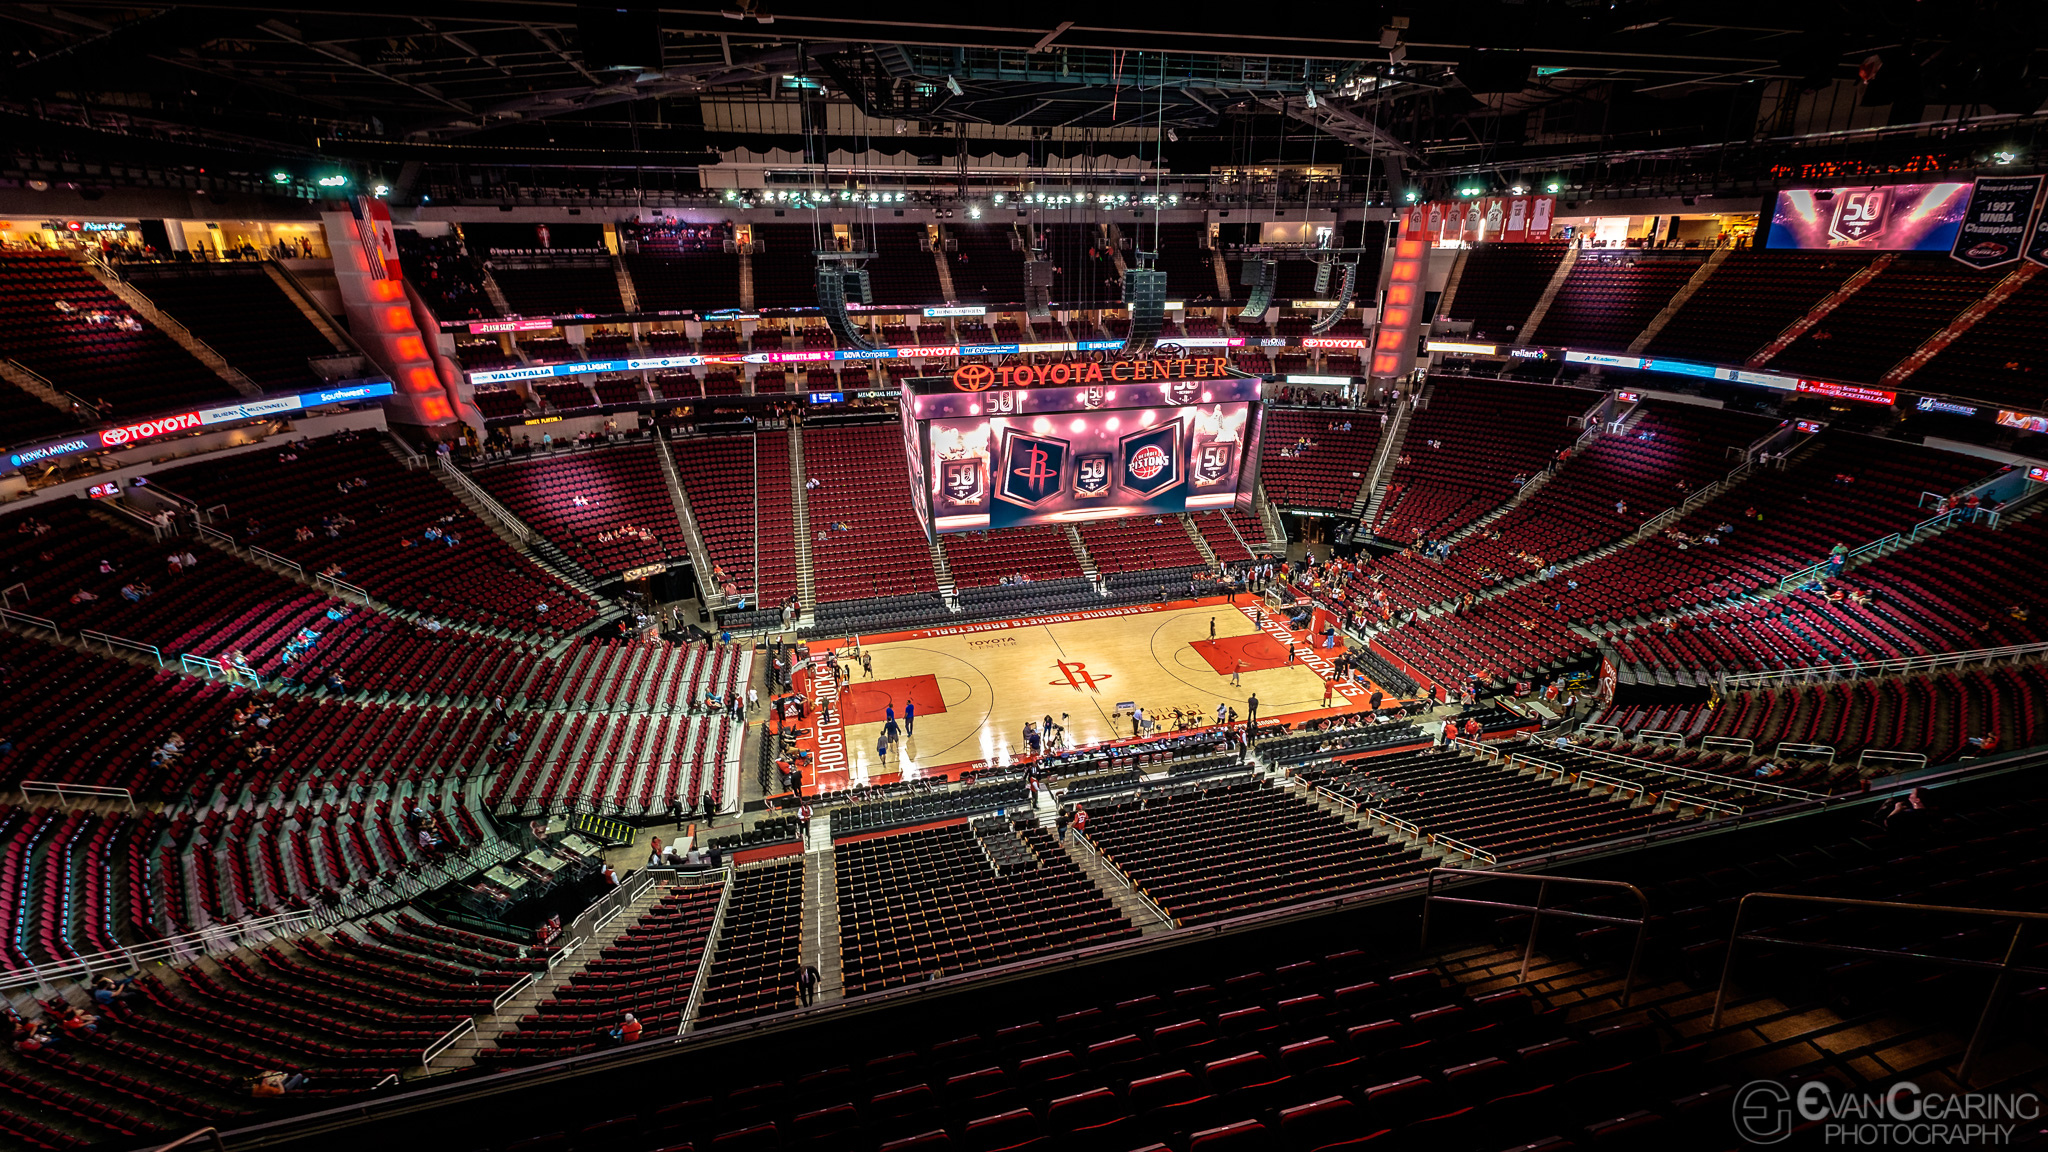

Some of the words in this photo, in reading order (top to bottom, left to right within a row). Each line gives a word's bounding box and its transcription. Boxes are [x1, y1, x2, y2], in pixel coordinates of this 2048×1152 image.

[1843, 193, 1884, 220] 50
[1987, 202, 2015, 211] 1997
[1980, 213, 2013, 222] WNBA
[1965, 223, 2023, 235] Champions
[1318, 340, 1364, 348] TOYOTA
[860, 351, 889, 359] Compass
[912, 347, 959, 356] TOYOTA
[1511, 350, 1538, 359] reliant
[569, 364, 587, 373] BUD
[587, 362, 612, 371] LIGHT
[996, 363, 1104, 387] TOYOTA
[1111, 357, 1228, 381] CENTER
[491, 369, 551, 380] VALVITALIA
[320, 389, 365, 402] Southwest
[986, 391, 1013, 412] 50
[127, 413, 200, 440] TOYOTA
[49, 440, 88, 456] MINOLTA
[1128, 455, 1169, 472] PISTONS
[1204, 447, 1228, 467] 50
[949, 464, 974, 486] 50
[1081, 459, 1105, 479] 50
[1082, 607, 1138, 620] SEASONS
[1013, 614, 1070, 627] ROCKETS
[923, 620, 1008, 638] BASKETBALL
[967, 637, 1016, 646] TOYOTA
[814, 661, 838, 706] ROCKET
